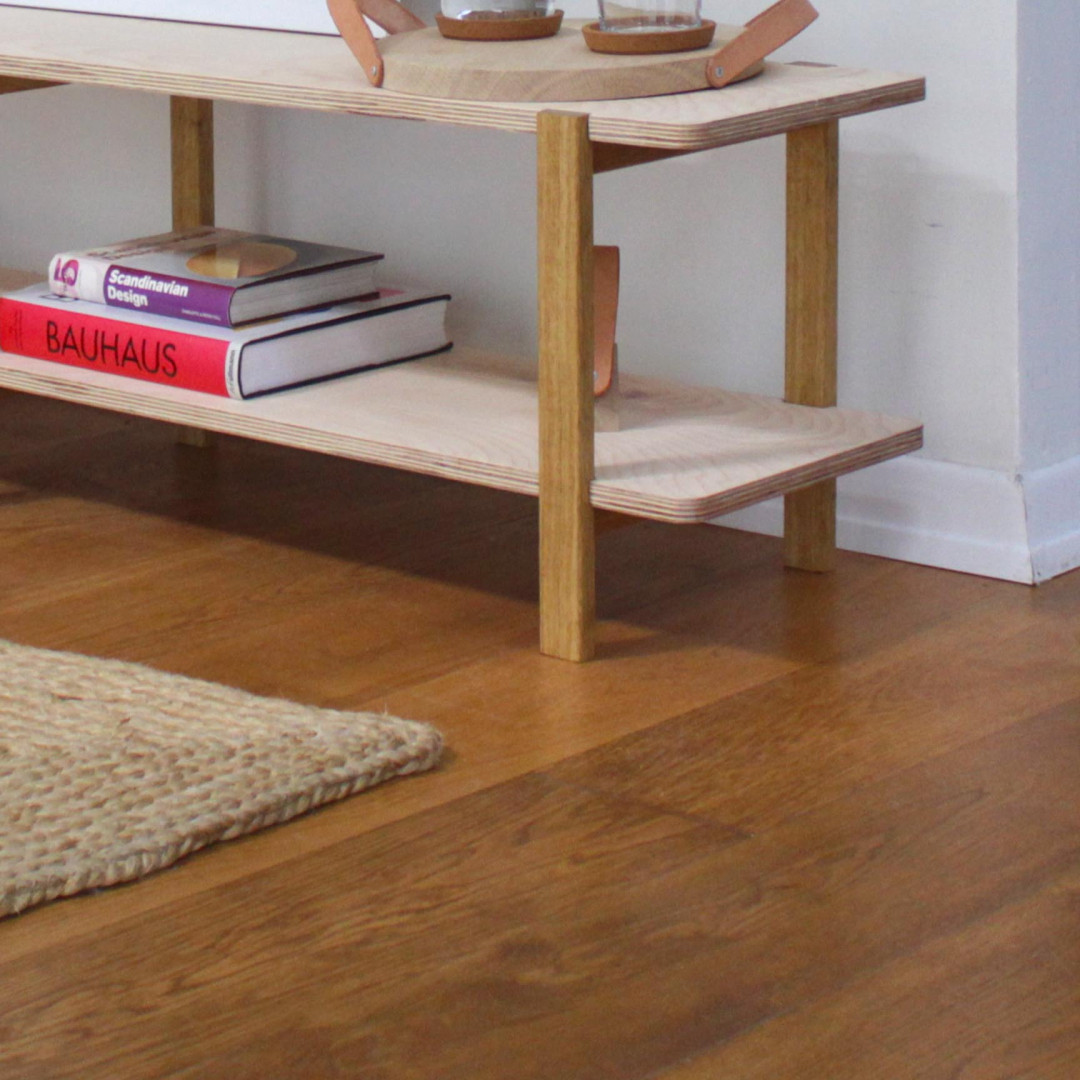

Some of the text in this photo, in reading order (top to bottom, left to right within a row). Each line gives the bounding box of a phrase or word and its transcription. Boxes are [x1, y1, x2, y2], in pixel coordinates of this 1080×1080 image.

[107, 285, 148, 307] Design
[108, 269, 189, 297] Scandinavian
[46, 320, 178, 378] BAUHAUS
